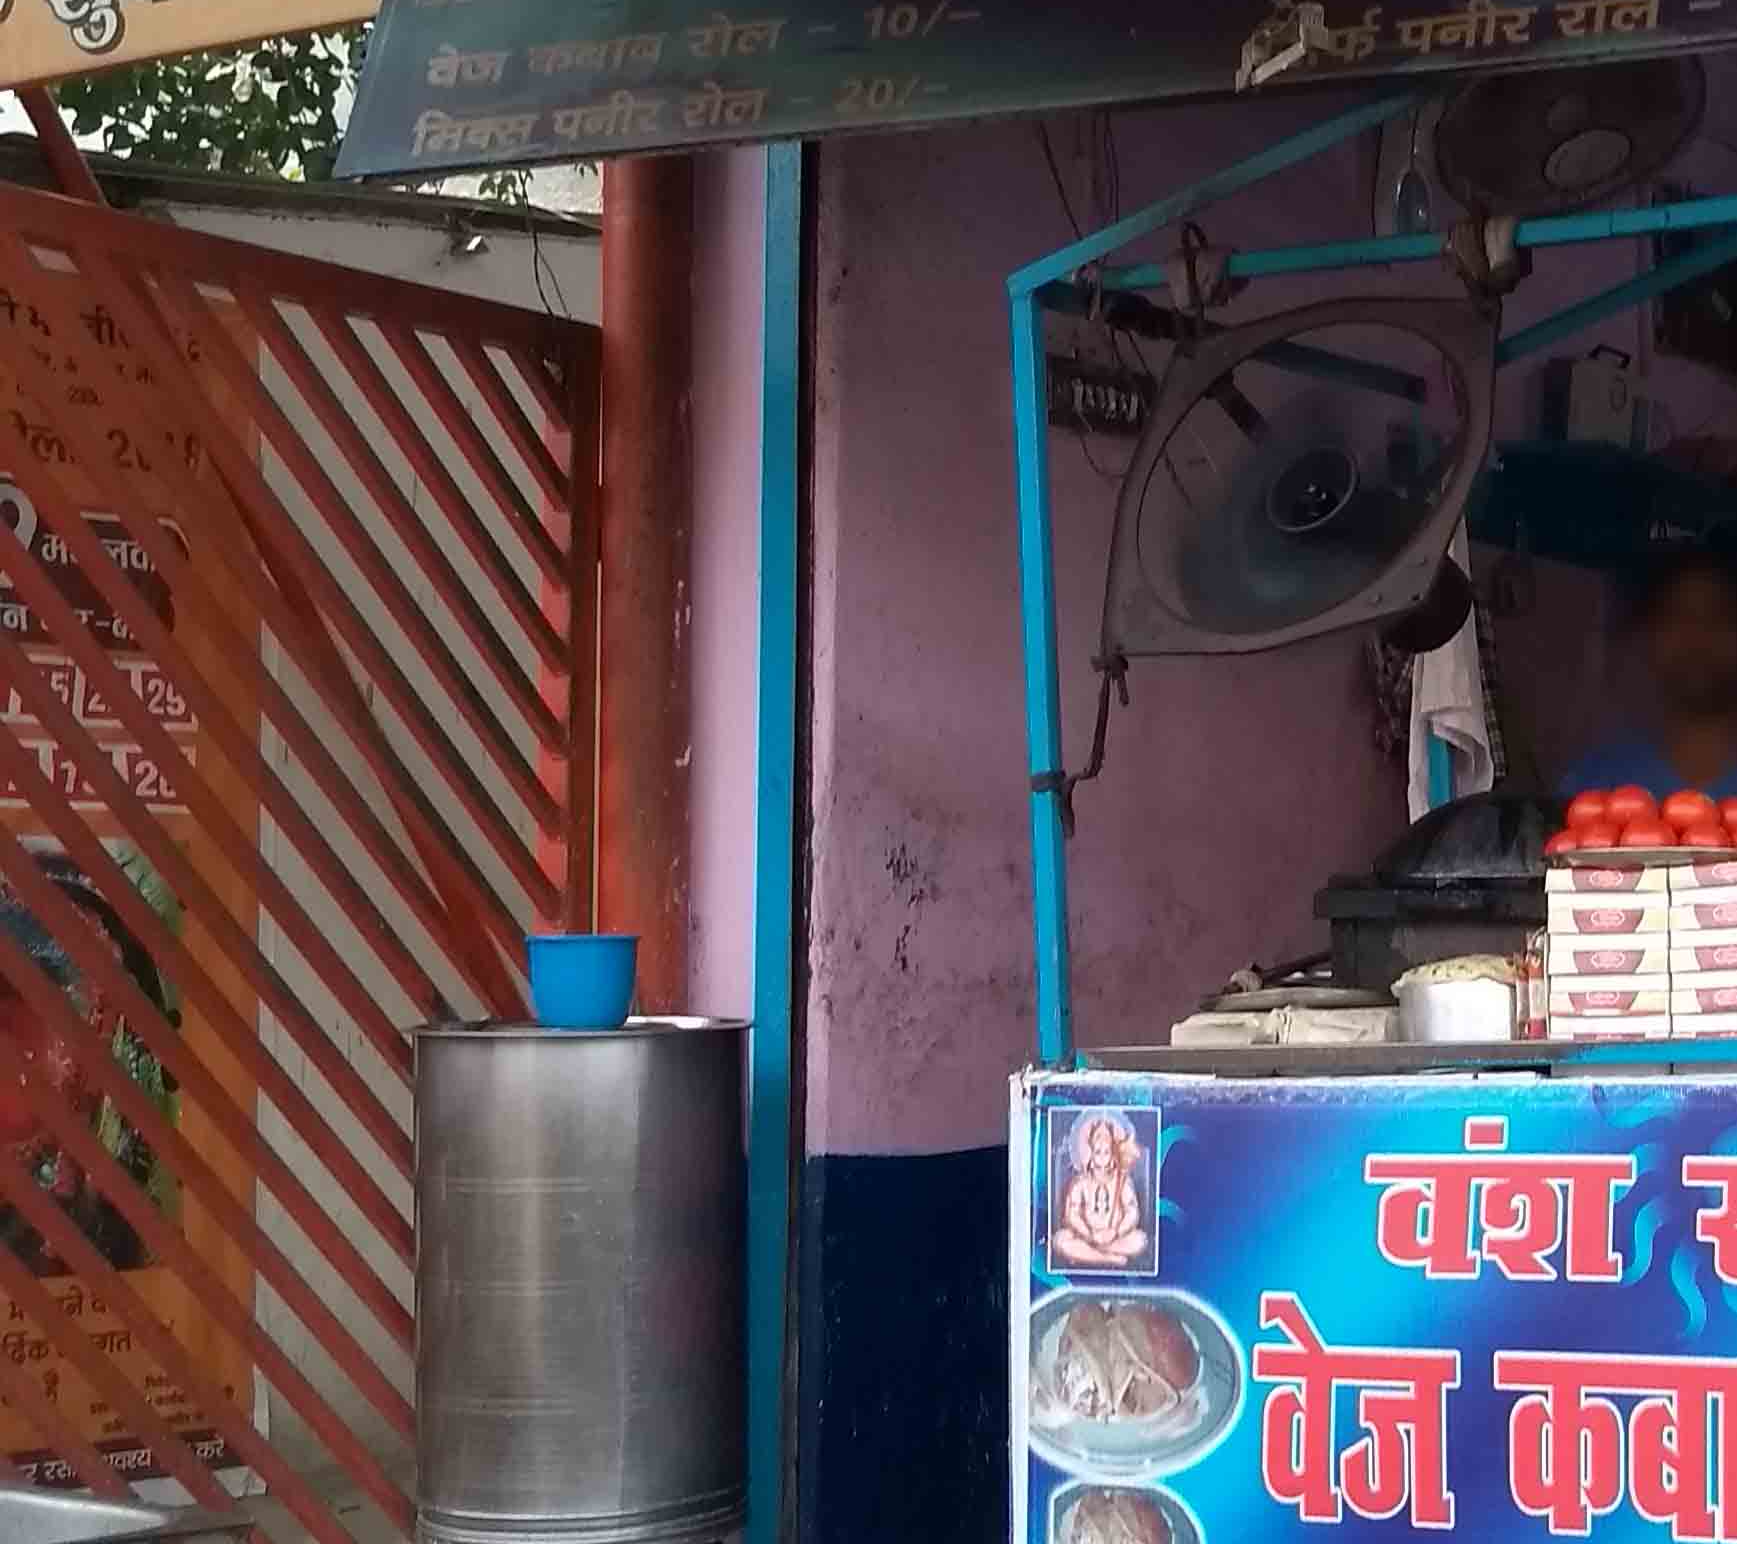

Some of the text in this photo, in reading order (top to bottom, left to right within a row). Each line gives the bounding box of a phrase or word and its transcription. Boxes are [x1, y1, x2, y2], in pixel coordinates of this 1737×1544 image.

[427, 44, 511, 89] वेज
[687, 12, 788, 58] रोल
[865, 1, 983, 42] 10/-
[412, 108, 540, 156] मिक्स
[551, 88, 670, 138] पनीर
[681, 79, 770, 130] रोल
[834, 73, 952, 114] 20/-
[1366, 1115, 1637, 1282] वंश
[1252, 1290, 1462, 1530] वेज
